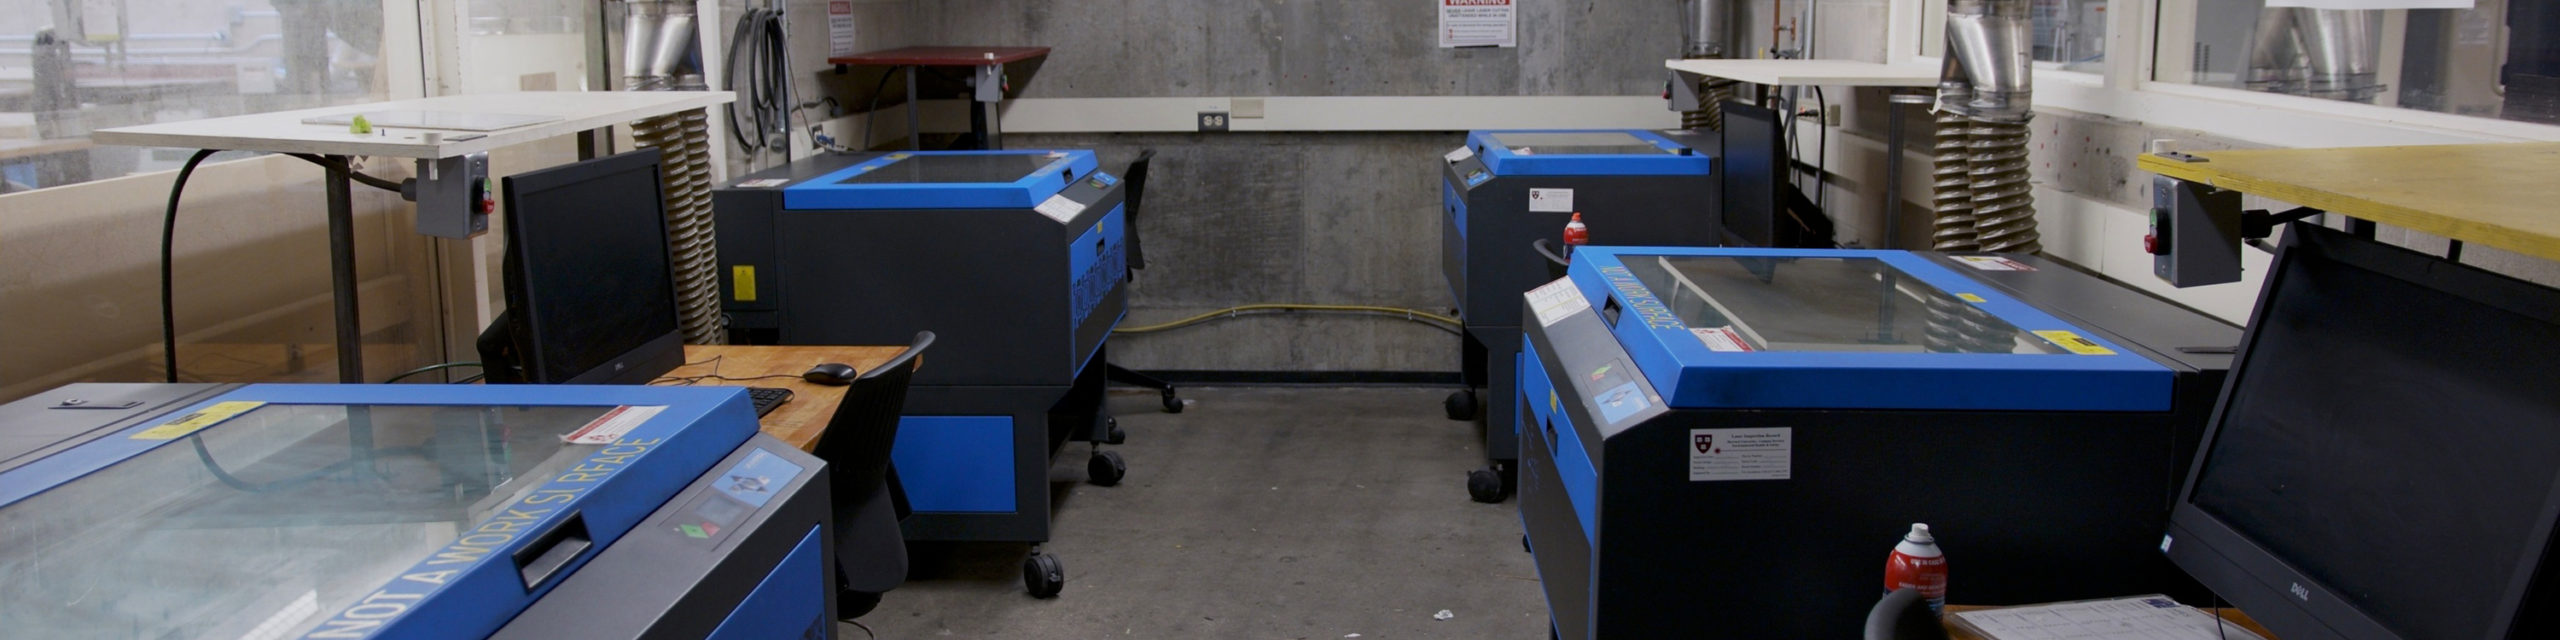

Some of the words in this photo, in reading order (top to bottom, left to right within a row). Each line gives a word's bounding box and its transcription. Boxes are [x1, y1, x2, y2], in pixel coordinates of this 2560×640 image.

[428, 508, 552, 564] WORK
[401, 568, 459, 584] A
[2290, 582, 2309, 601] DELL
[307, 590, 425, 639] NOT
